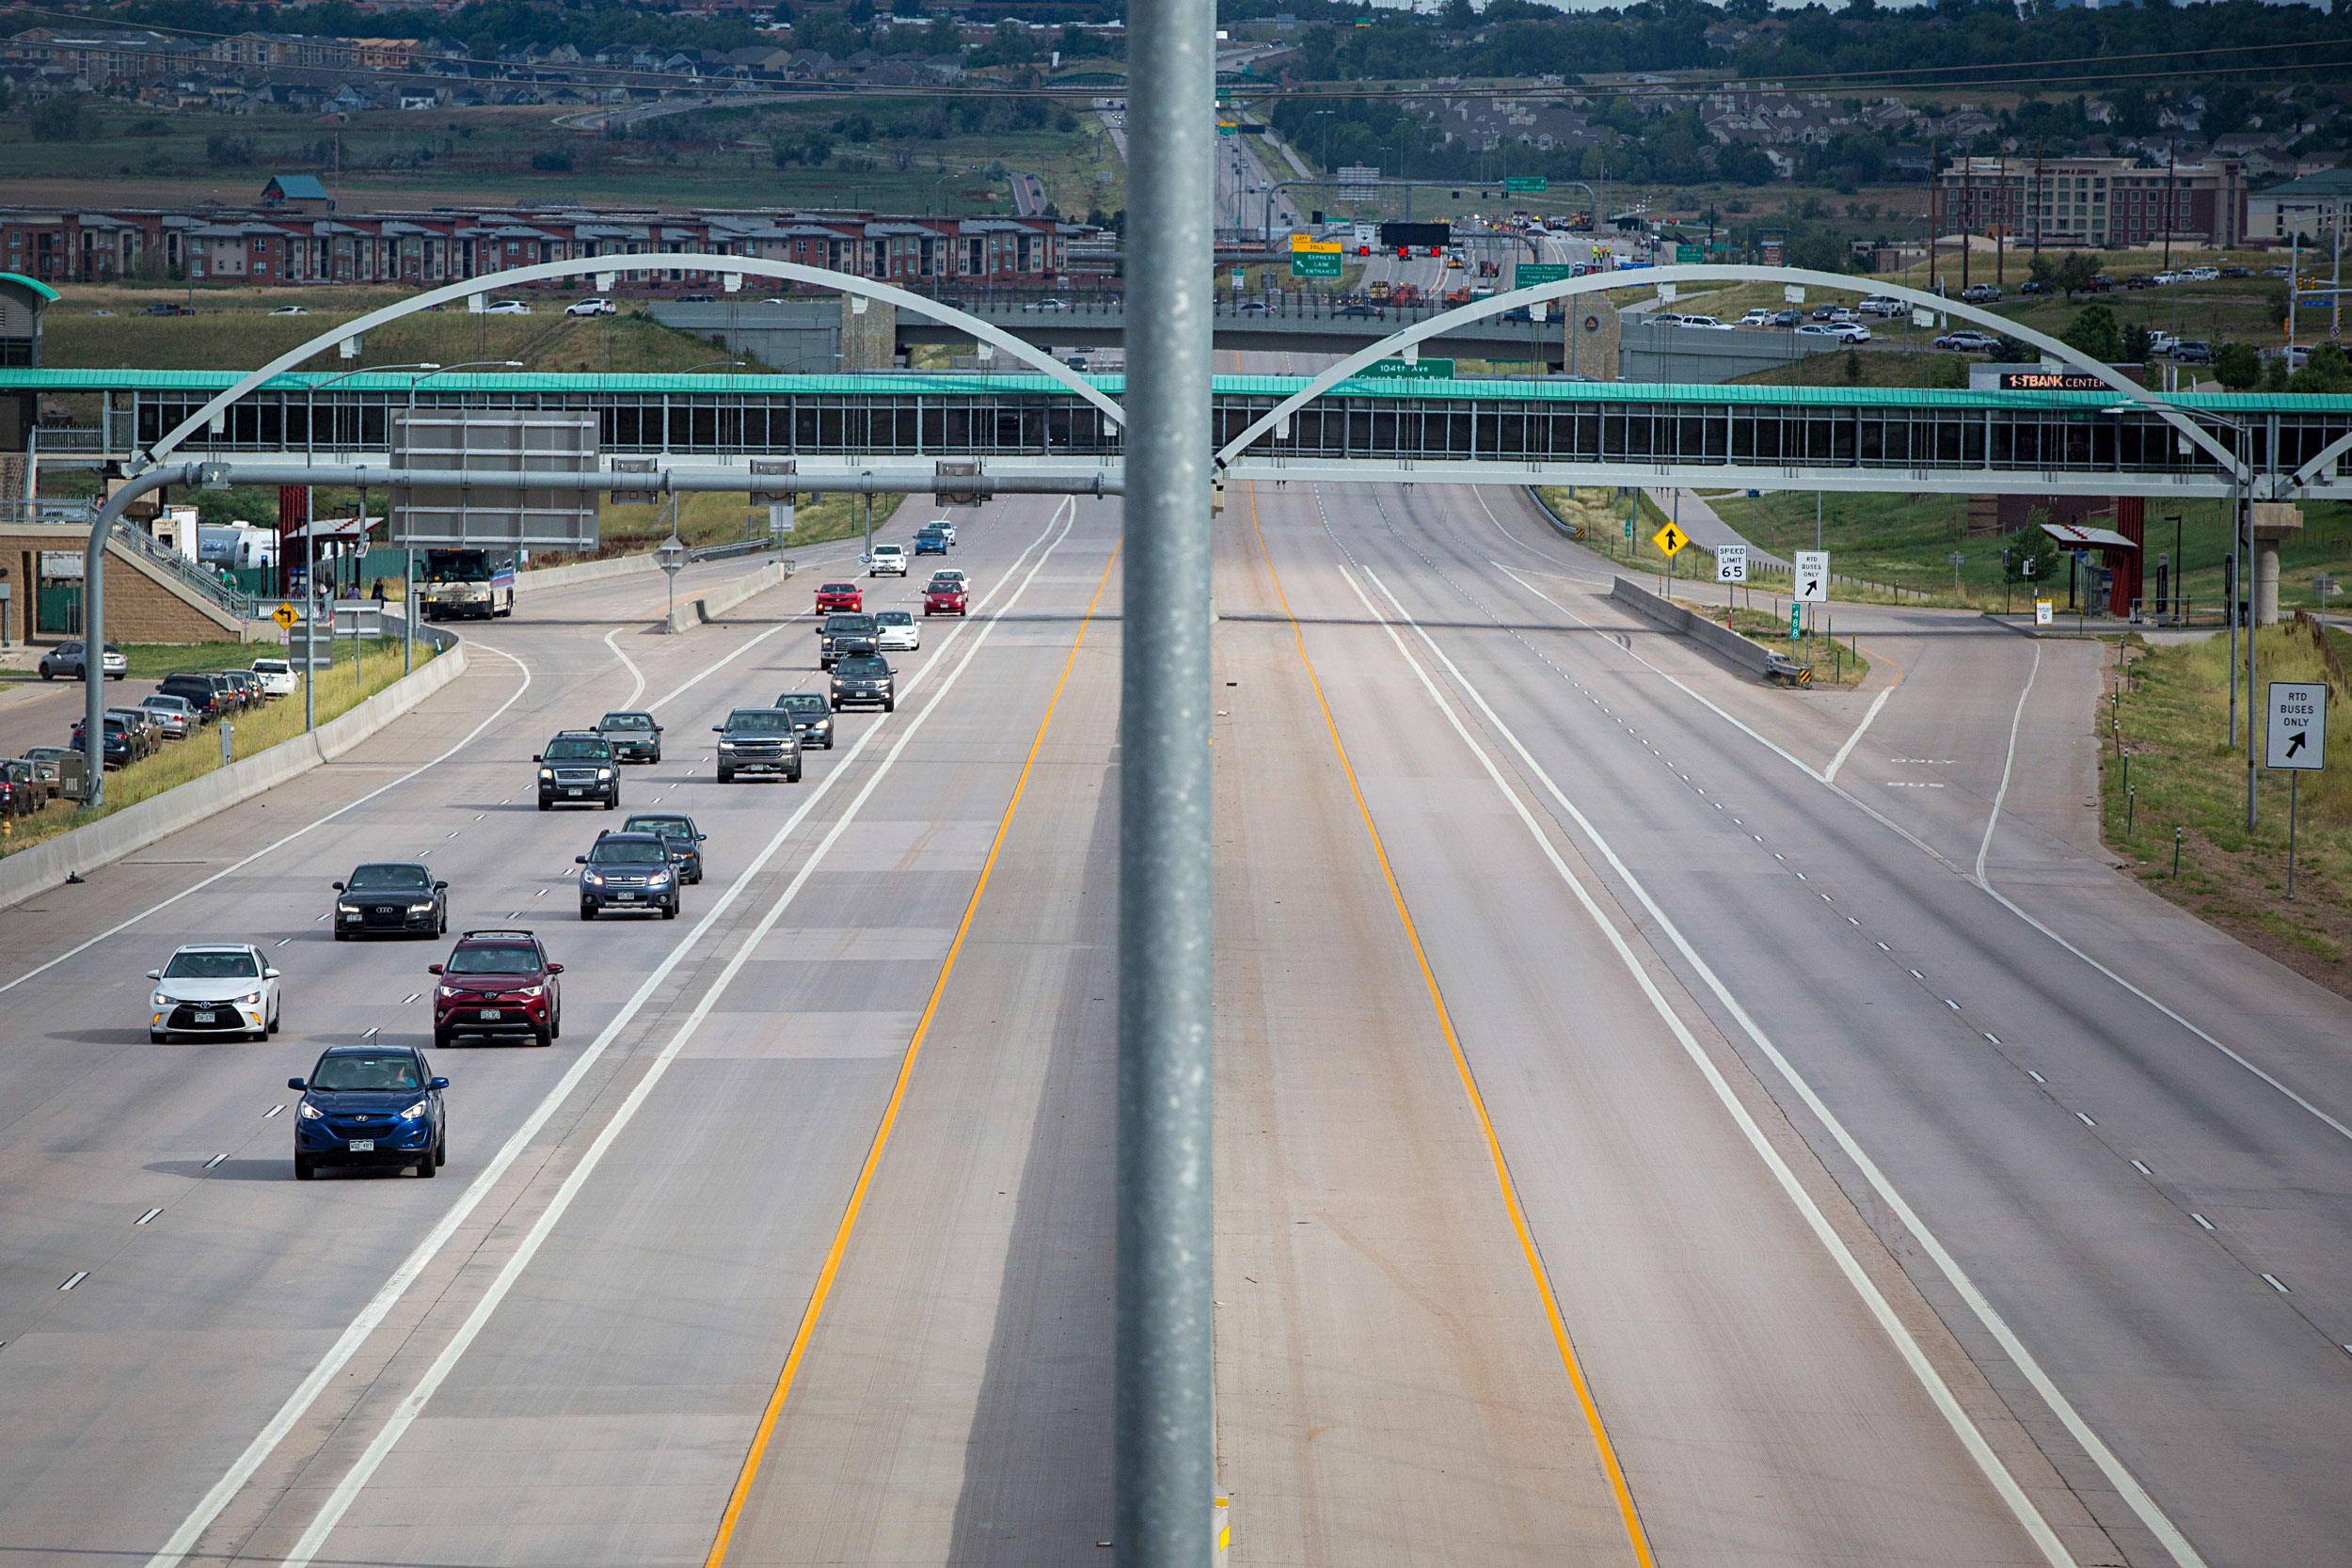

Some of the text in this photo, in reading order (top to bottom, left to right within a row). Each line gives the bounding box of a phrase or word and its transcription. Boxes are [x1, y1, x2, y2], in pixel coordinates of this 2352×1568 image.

[1380, 364, 1429, 372] 104th Ave
[2065, 378, 2106, 388] CENTER
[1722, 566, 1742, 578] 65
[2288, 691, 2308, 702] RTD
[2280, 705, 2314, 715] BUSES
[2283, 717, 2310, 727] ONLY
